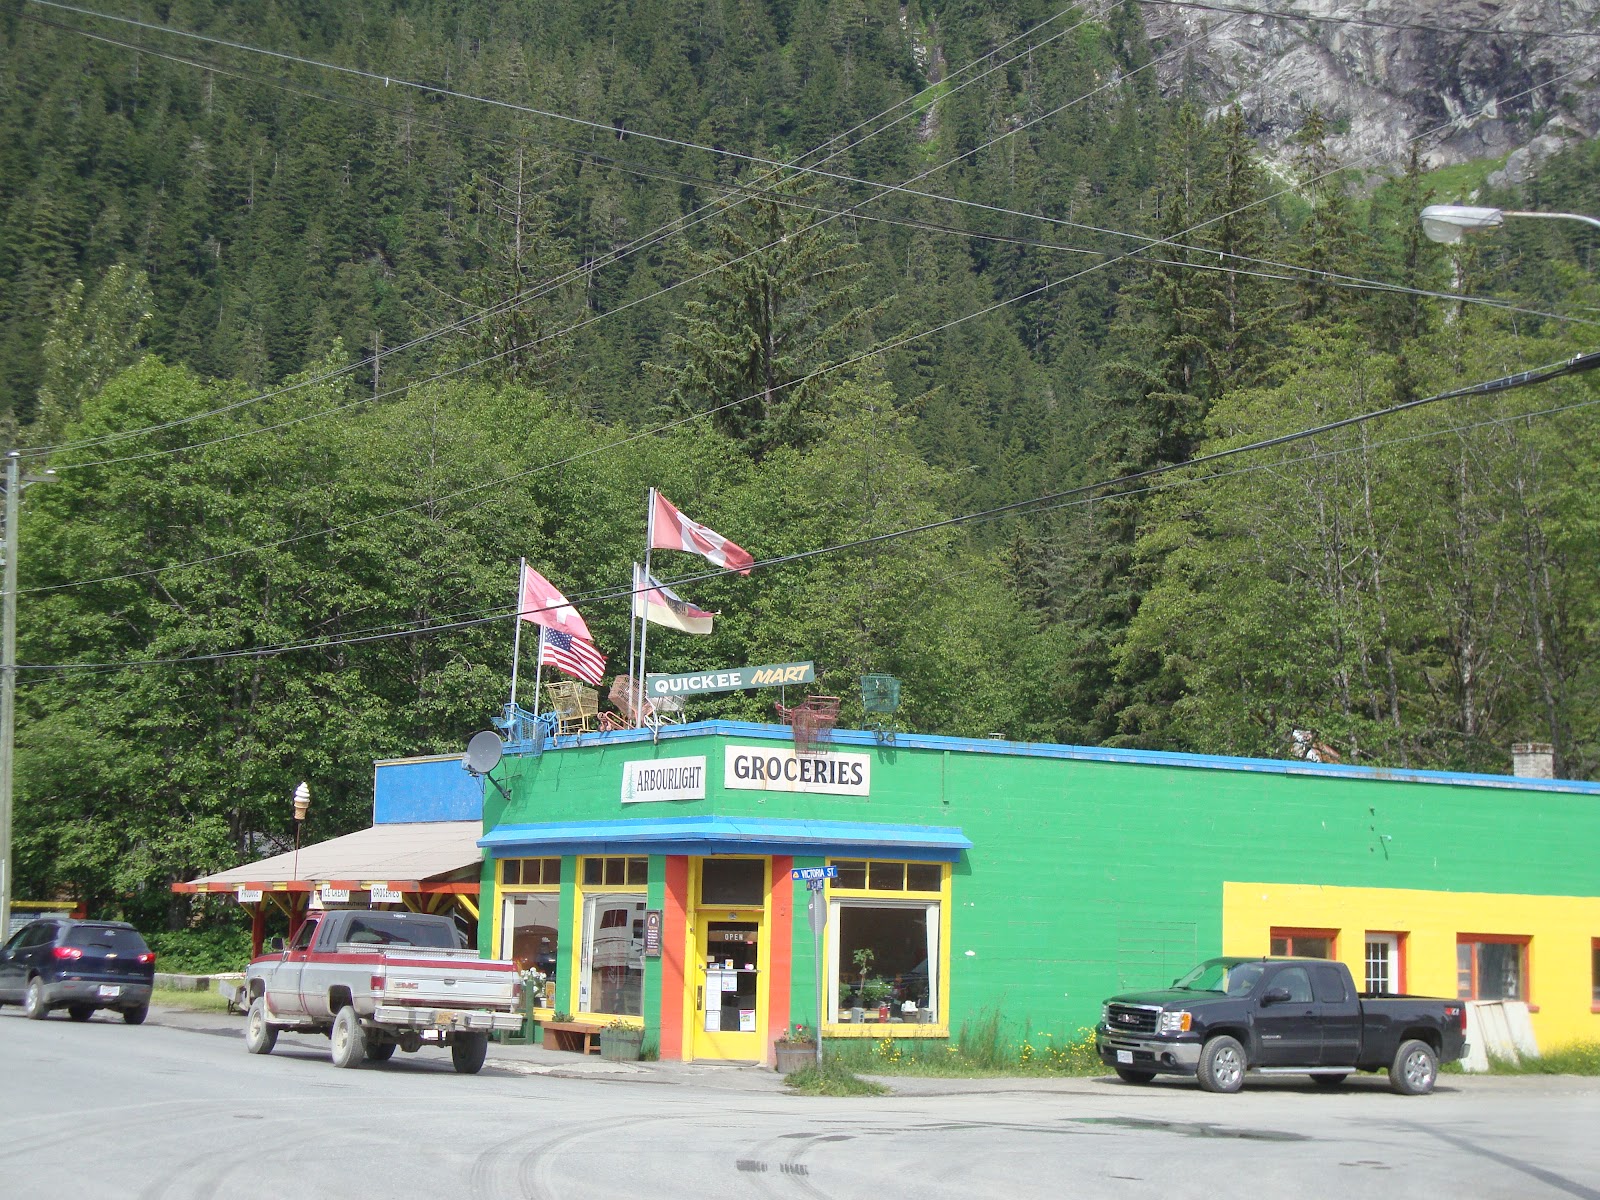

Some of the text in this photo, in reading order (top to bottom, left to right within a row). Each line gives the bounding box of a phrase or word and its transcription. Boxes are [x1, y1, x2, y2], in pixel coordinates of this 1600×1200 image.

[654, 664, 810, 694] QUICKEE MART
[734, 754, 863, 786] GROCERIES
[636, 766, 702, 792] ARBOURLIGHT
[800, 867, 834, 879] VICTORIA ST
[322, 887, 348, 898] ICE CREAM
[372, 887, 400, 898] GROCERIES
[724, 933, 744, 941] OPEN
